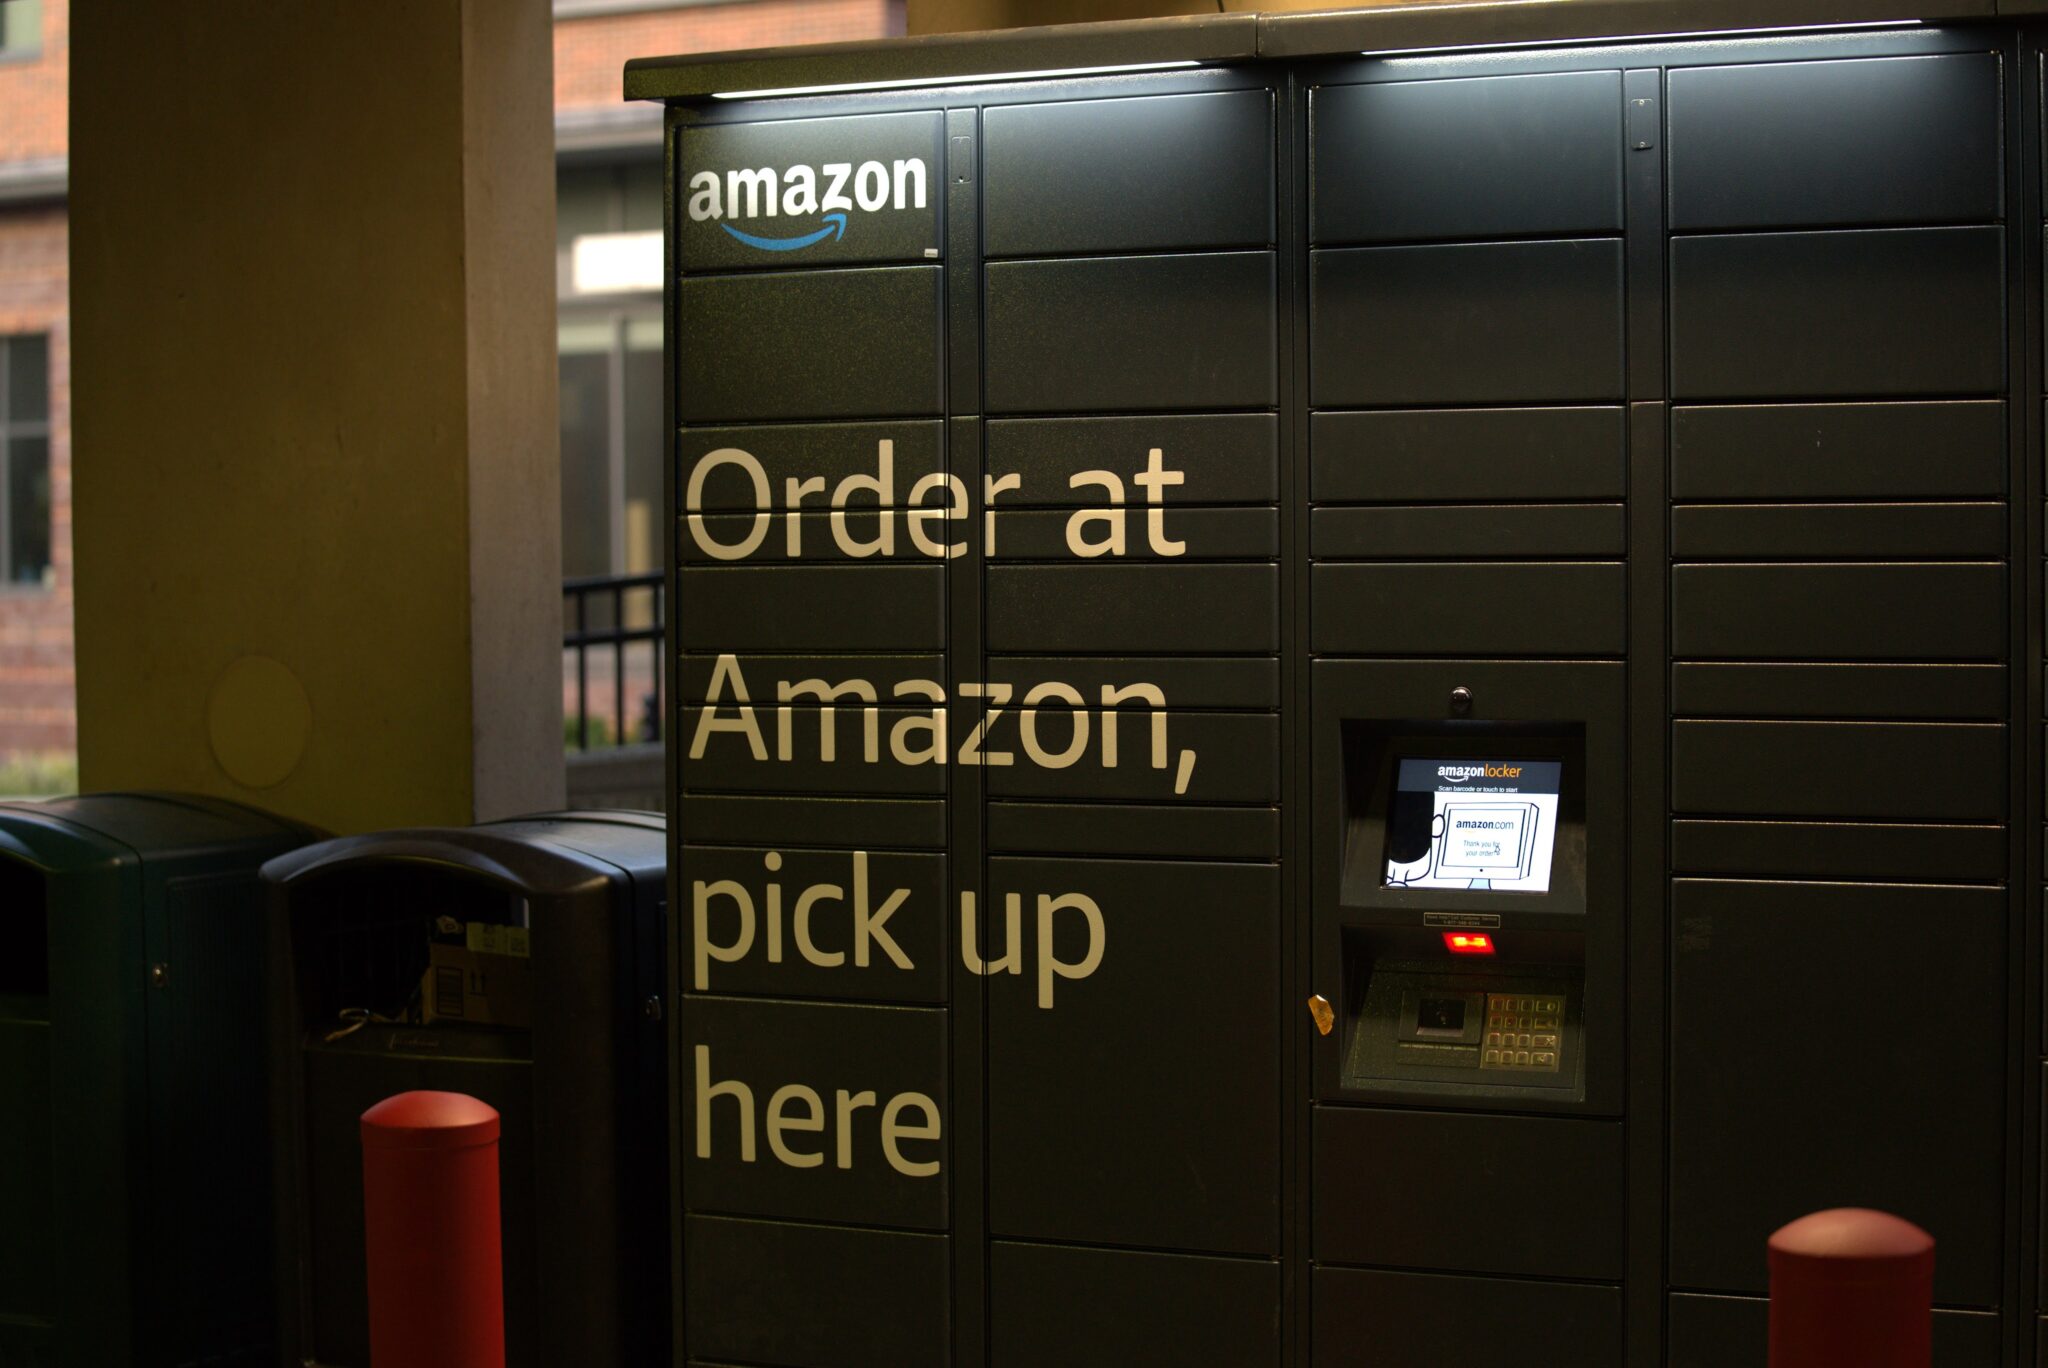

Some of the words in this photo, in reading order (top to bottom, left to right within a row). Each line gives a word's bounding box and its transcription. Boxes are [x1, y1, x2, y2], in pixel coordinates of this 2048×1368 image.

[688, 157, 927, 222] amazon
[686, 439, 1021, 560] Order
[1065, 448, 1186, 557] at
[689, 653, 1197, 795] Amazon,
[1438, 785, 1453, 793] Scan
[1453, 786, 1476, 794] barcode
[1456, 820, 1514, 830] amazon.com
[1481, 841, 1492, 849] you
[693, 852, 914, 990] pick
[961, 890, 1106, 1009] up
[695, 1044, 942, 1178] here
